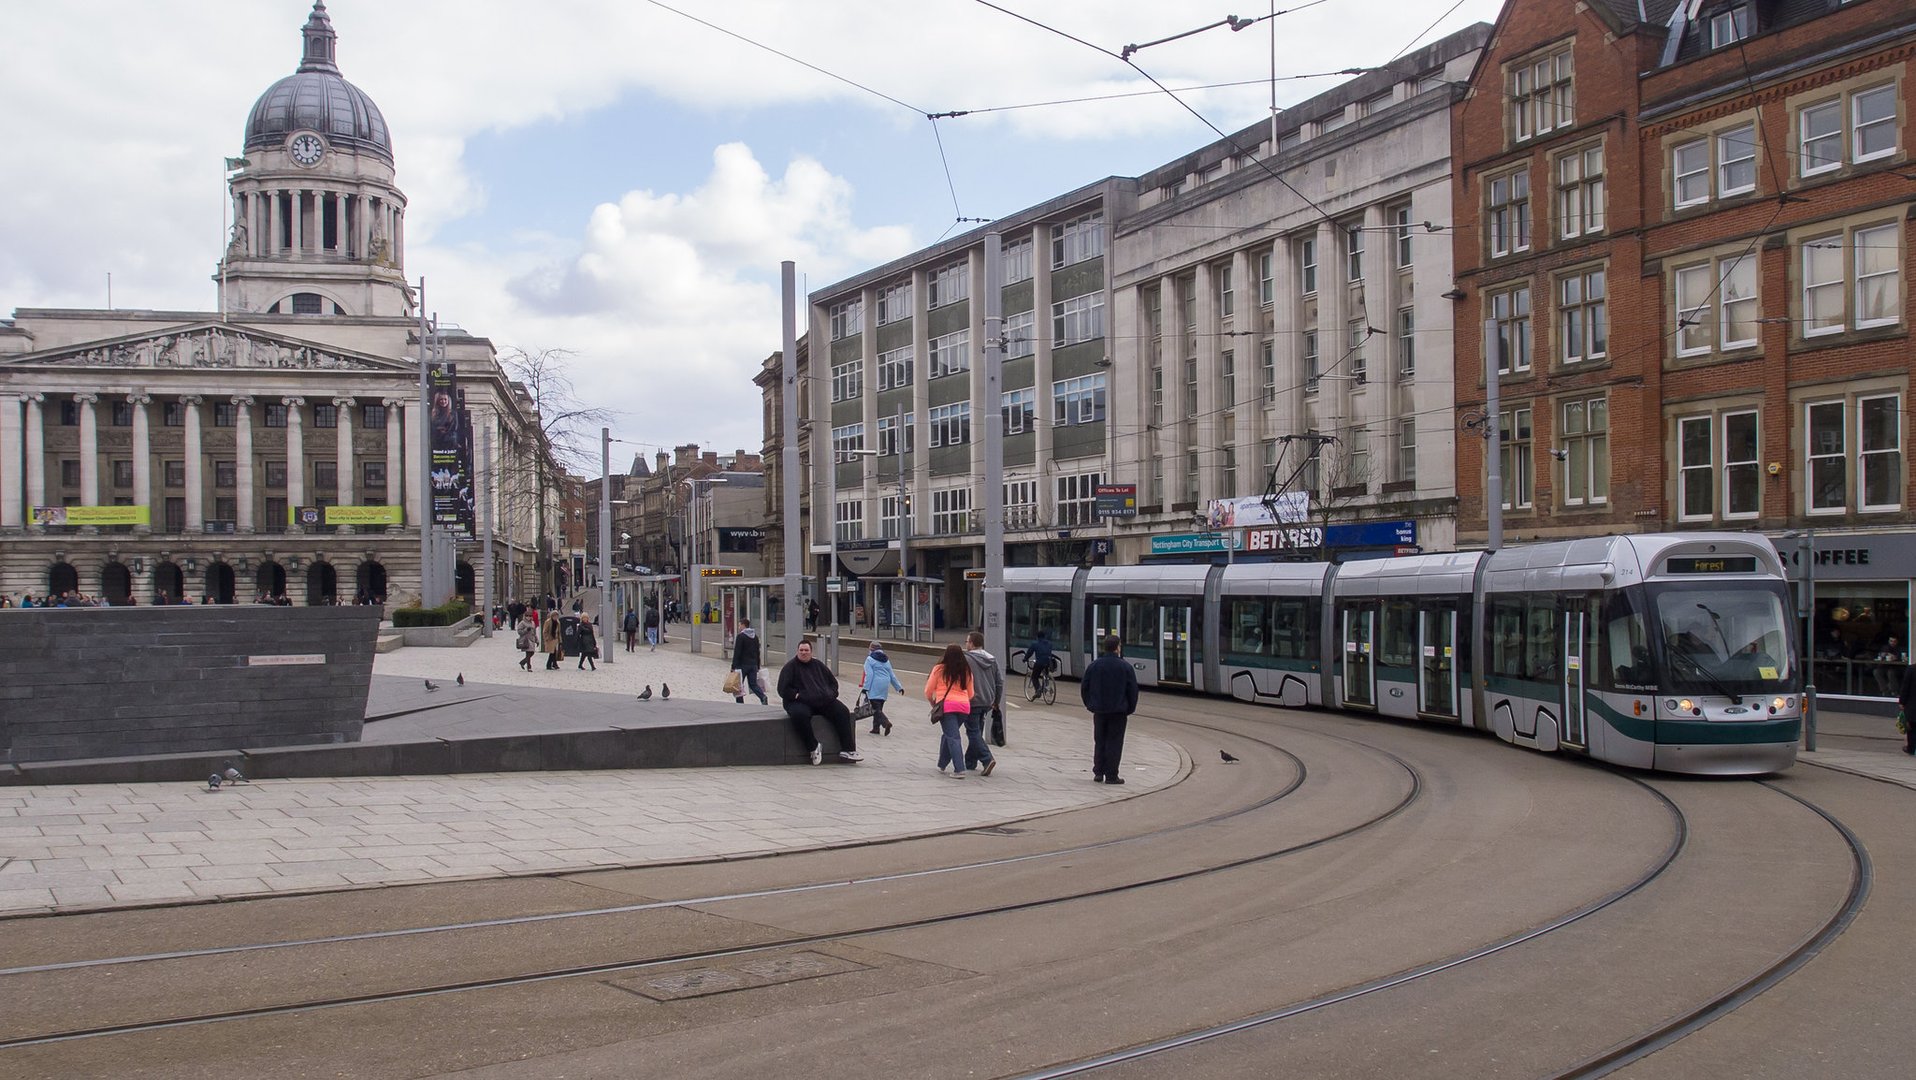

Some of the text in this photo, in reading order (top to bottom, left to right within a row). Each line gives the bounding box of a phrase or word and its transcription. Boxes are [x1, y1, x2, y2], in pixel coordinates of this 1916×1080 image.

[1152, 538, 1220, 550] Nottingham City Transport
[1695, 559, 1725, 571] Forest
[1620, 568, 1634, 576] 214
